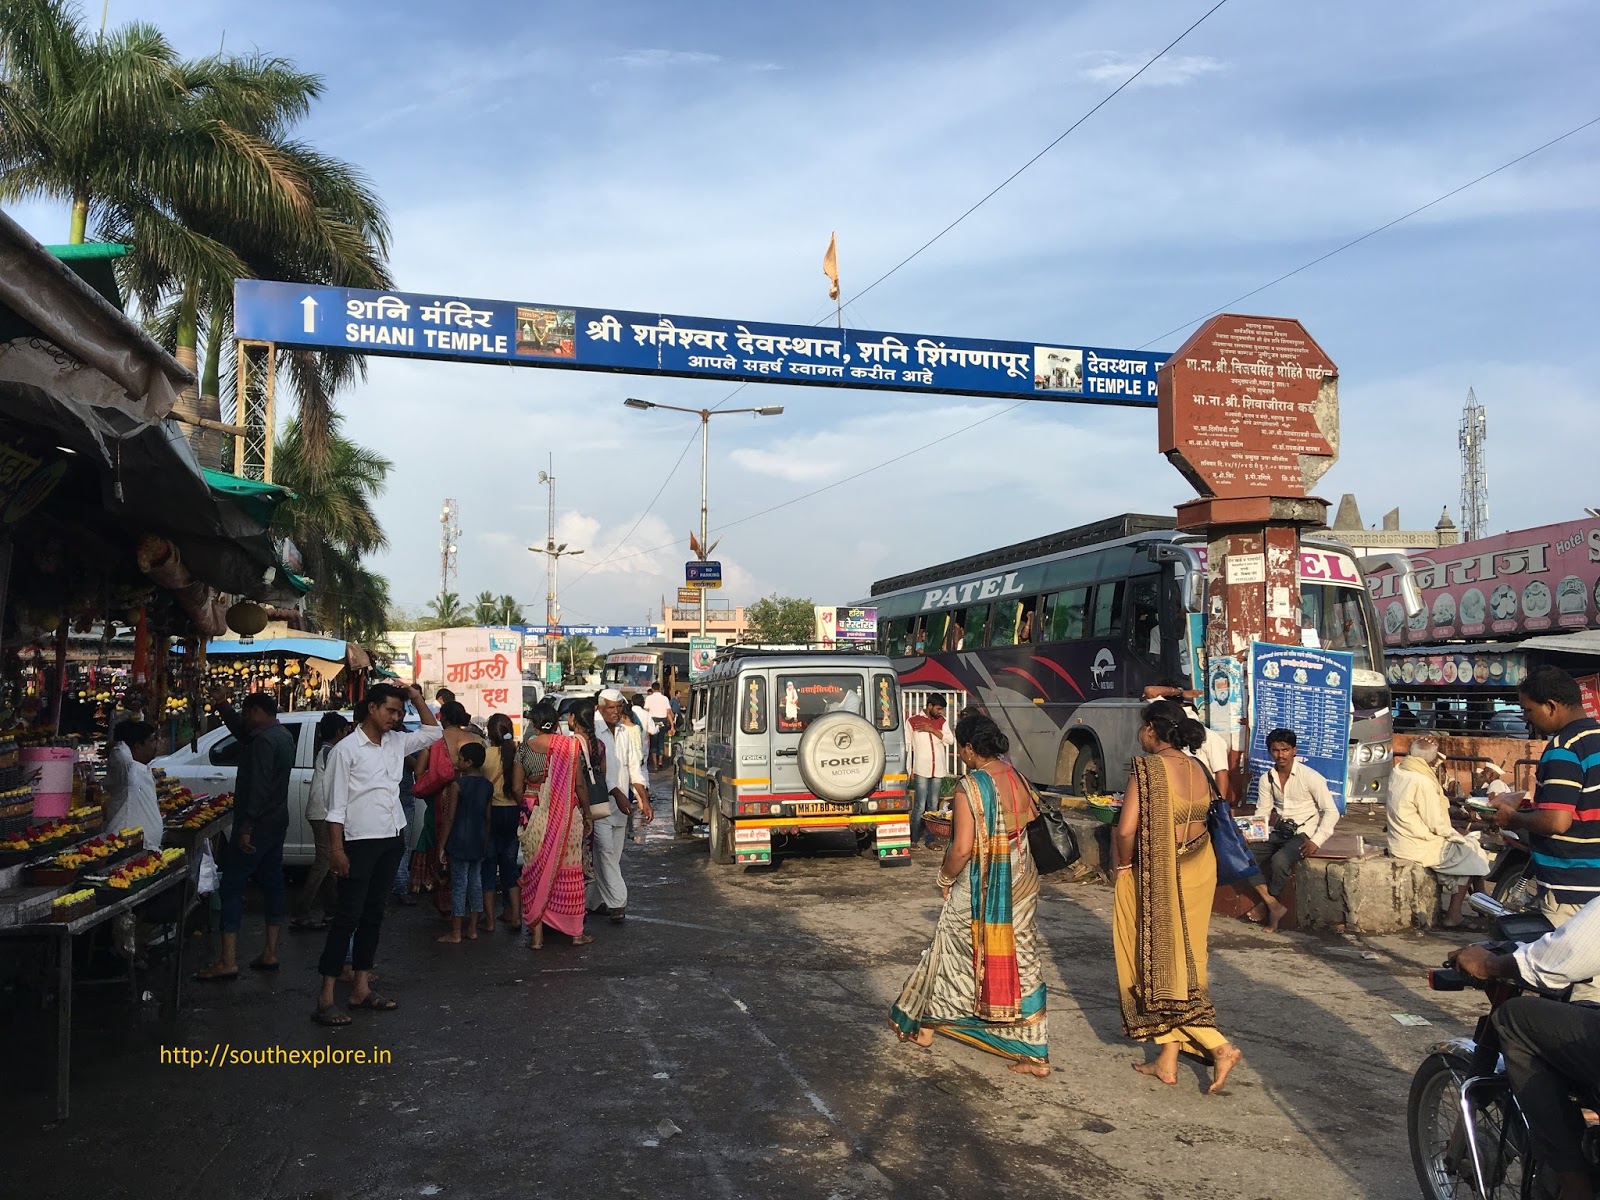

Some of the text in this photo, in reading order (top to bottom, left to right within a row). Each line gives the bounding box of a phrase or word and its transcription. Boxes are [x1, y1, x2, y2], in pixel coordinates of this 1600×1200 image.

[346, 296, 493, 328] शनि मंदिर
[346, 324, 508, 353] SHANI TEMPLE
[585, 314, 1030, 380] श्री शनैश्वर देवस्थान, शनि शिंगणापूर
[688, 354, 934, 384] आपले सहर्ष स्वागत करीत आहे
[1087, 351, 1147, 375] देवस्थान
[1276, 361, 1302, 379] मोहिते
[1088, 377, 1142, 395] TEMPLE
[1556, 528, 1584, 556] Hotel
[922, 572, 1024, 610] PATEL
[447, 654, 509, 682] माऊली
[482, 688, 508, 708] दूध
[821, 756, 869, 767] FORCE
